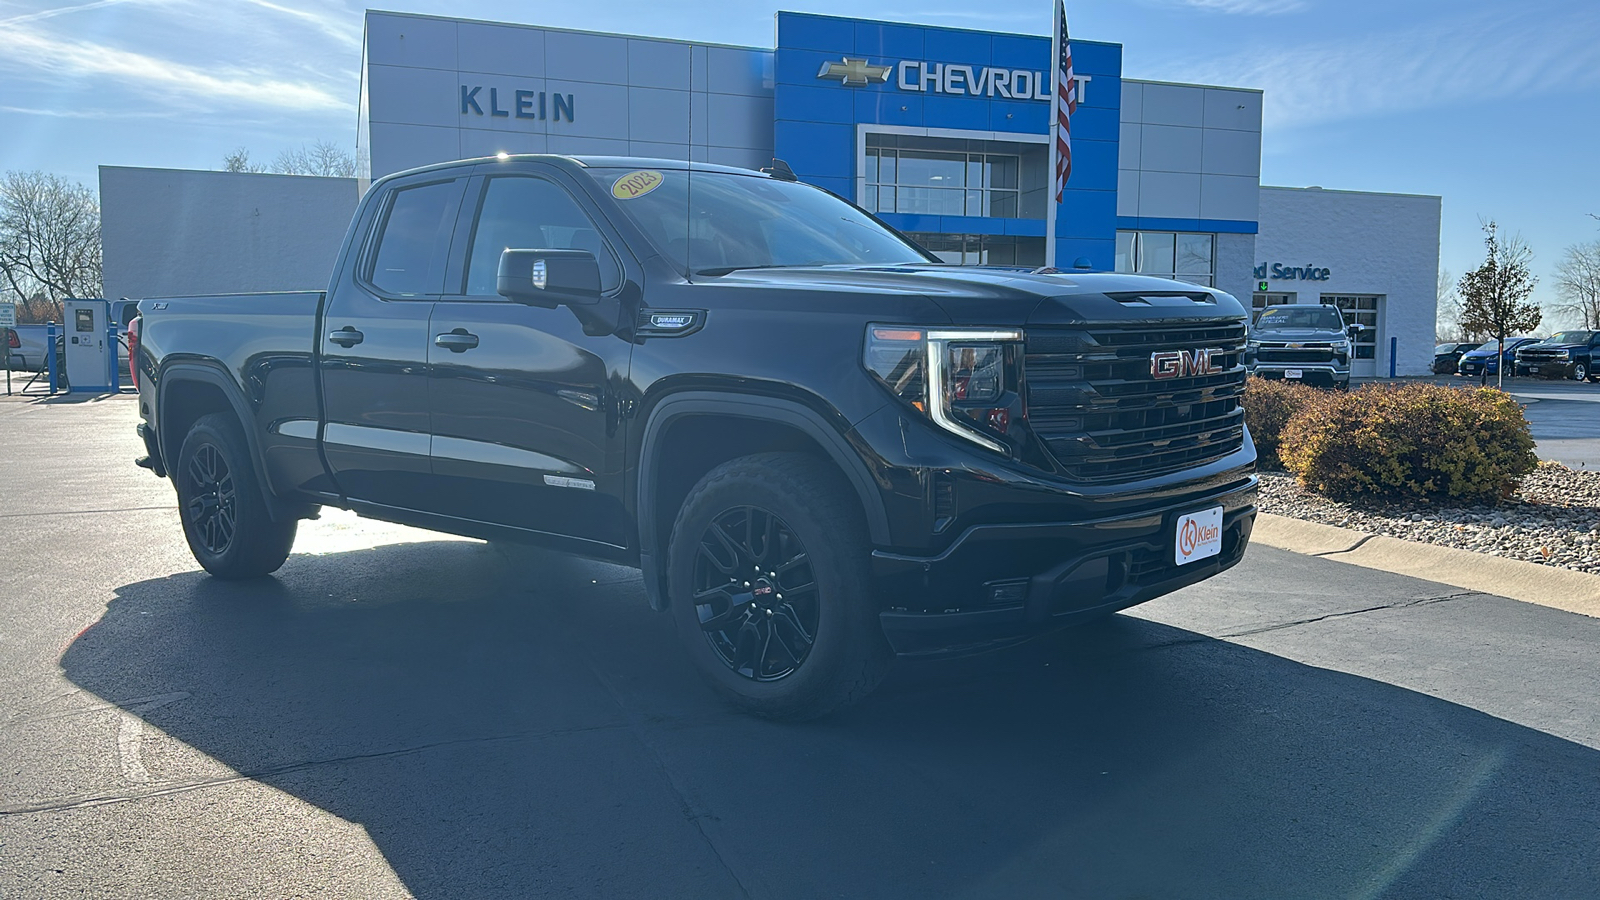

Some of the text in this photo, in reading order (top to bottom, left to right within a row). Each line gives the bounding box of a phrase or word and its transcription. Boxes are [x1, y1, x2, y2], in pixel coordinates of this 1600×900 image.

[899, 60, 1092, 104] CHEVROLT
[461, 84, 575, 123] KLEIN
[620, 171, 657, 196] 2023
[1271, 263, 1331, 281] Service
[1150, 347, 1224, 380] GMC
[1197, 524, 1219, 543] Klein
